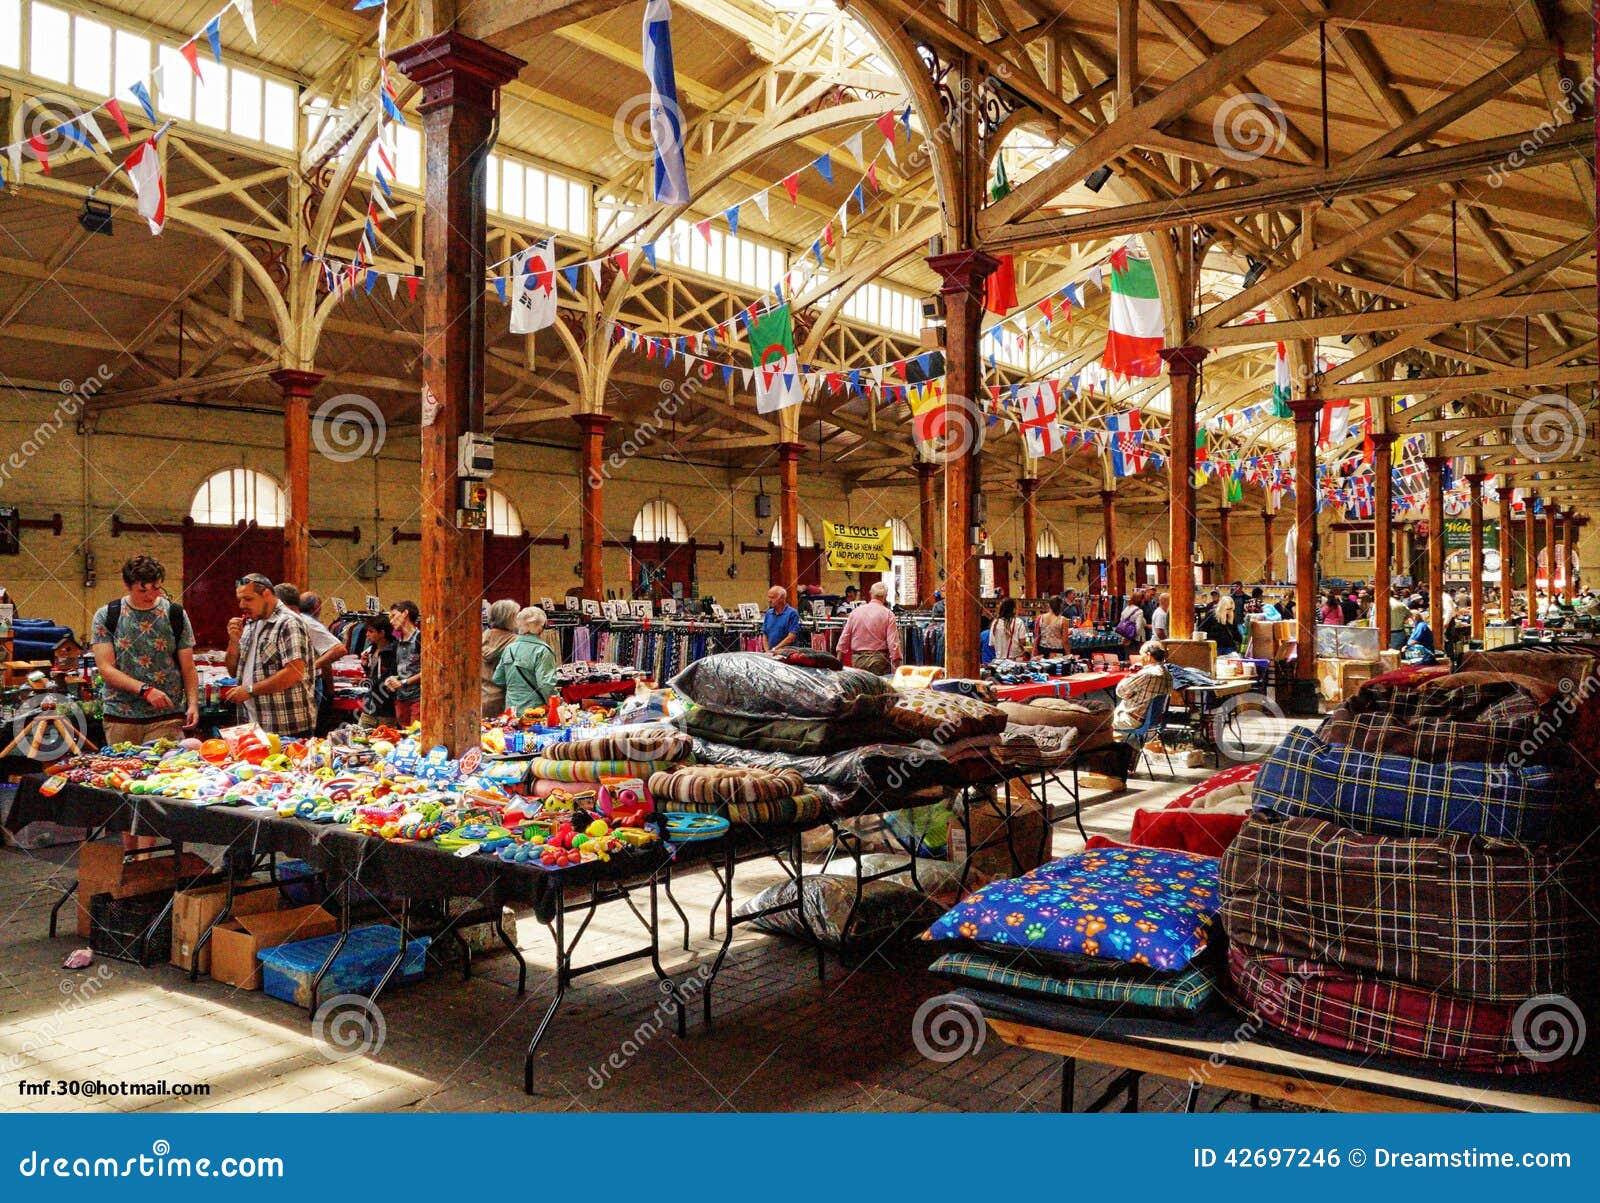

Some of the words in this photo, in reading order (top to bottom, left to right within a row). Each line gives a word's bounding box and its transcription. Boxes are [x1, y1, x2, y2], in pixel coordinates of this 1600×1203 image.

[834, 524, 846, 534] FB
[848, 525, 879, 537] TOOLS
[1445, 522, 1492, 532] Welce
[828, 541, 853, 551] SUPPLIER
[635, 605, 645, 617] 15
